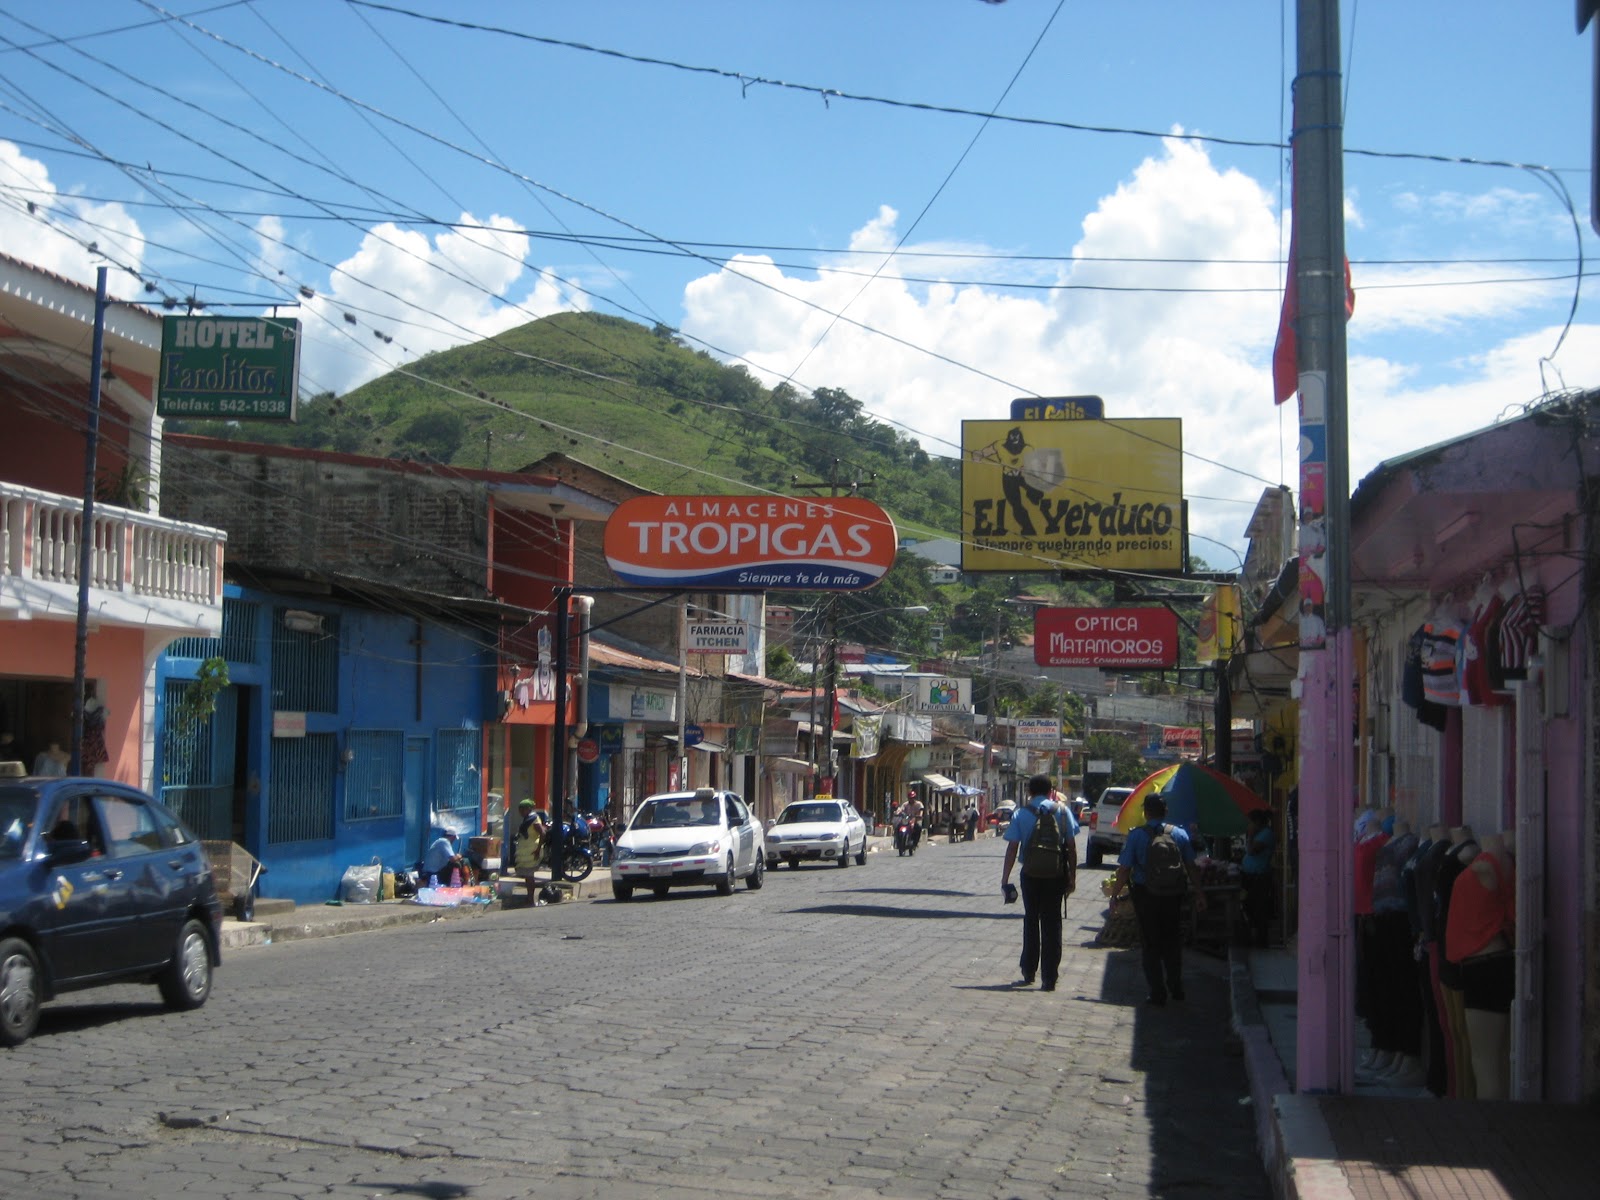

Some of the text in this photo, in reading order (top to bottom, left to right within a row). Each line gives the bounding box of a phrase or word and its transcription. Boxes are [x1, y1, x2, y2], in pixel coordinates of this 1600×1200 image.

[175, 320, 274, 349] HOTEL
[162, 397, 286, 413] Telefax: 542-1938
[665, 502, 834, 518] ALMACENES
[972, 498, 1009, 536] El
[628, 521, 872, 557] TROPIGAS
[1037, 537, 1112, 553] quebrando
[1116, 537, 1173, 553] precios!
[738, 572, 860, 585] Siempre te da más
[690, 626, 745, 636] FARMACIA
[1075, 616, 1138, 631] OPTICA
[696, 637, 740, 647] ITCHEN
